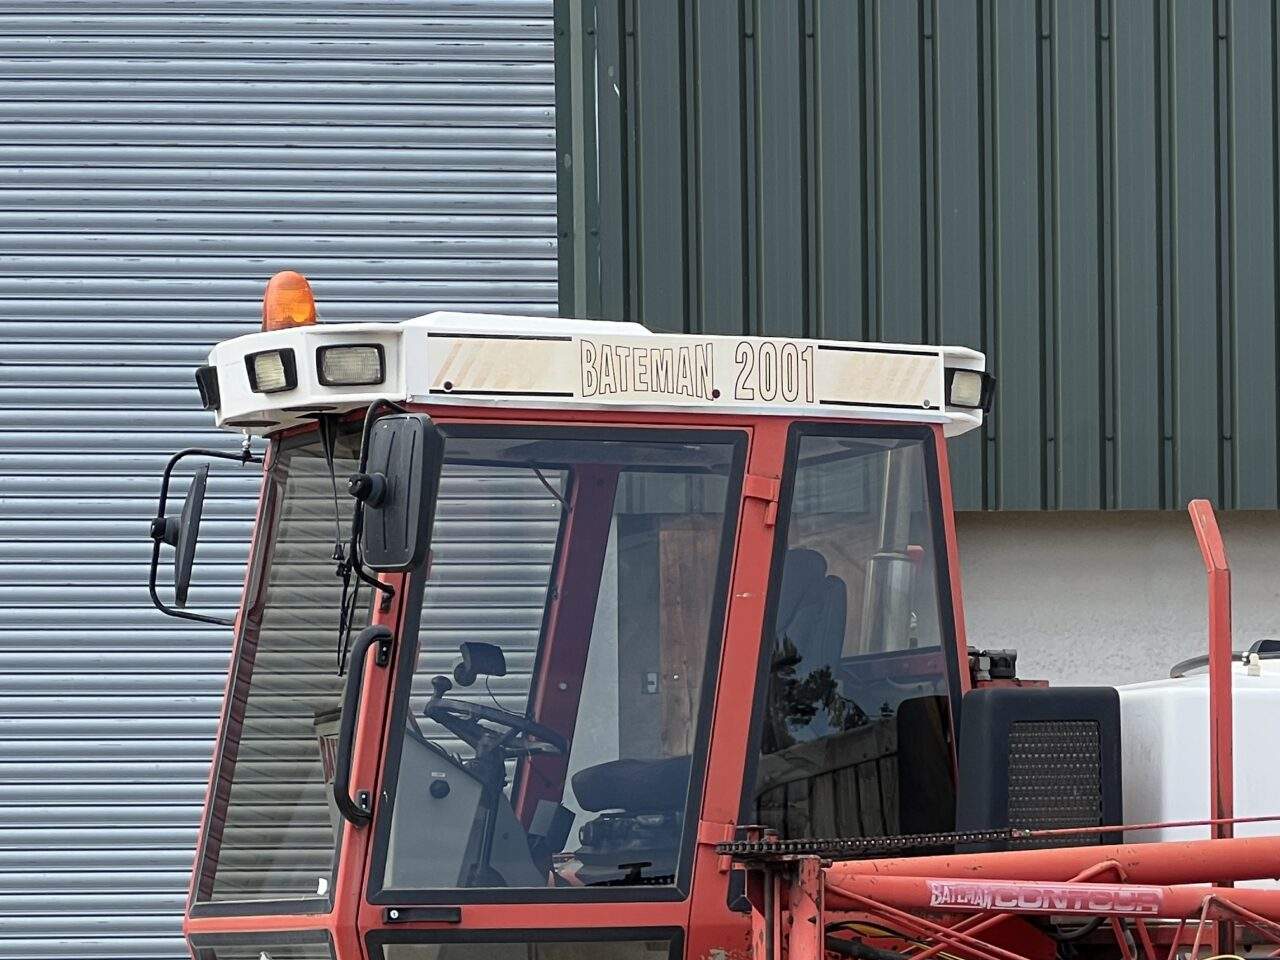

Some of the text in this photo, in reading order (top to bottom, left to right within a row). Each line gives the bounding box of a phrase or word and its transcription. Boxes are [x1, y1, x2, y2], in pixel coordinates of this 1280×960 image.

[580, 339, 814, 403] BATEMAN 2001
[930, 882, 1160, 915] BATEMAN CONTOUR
